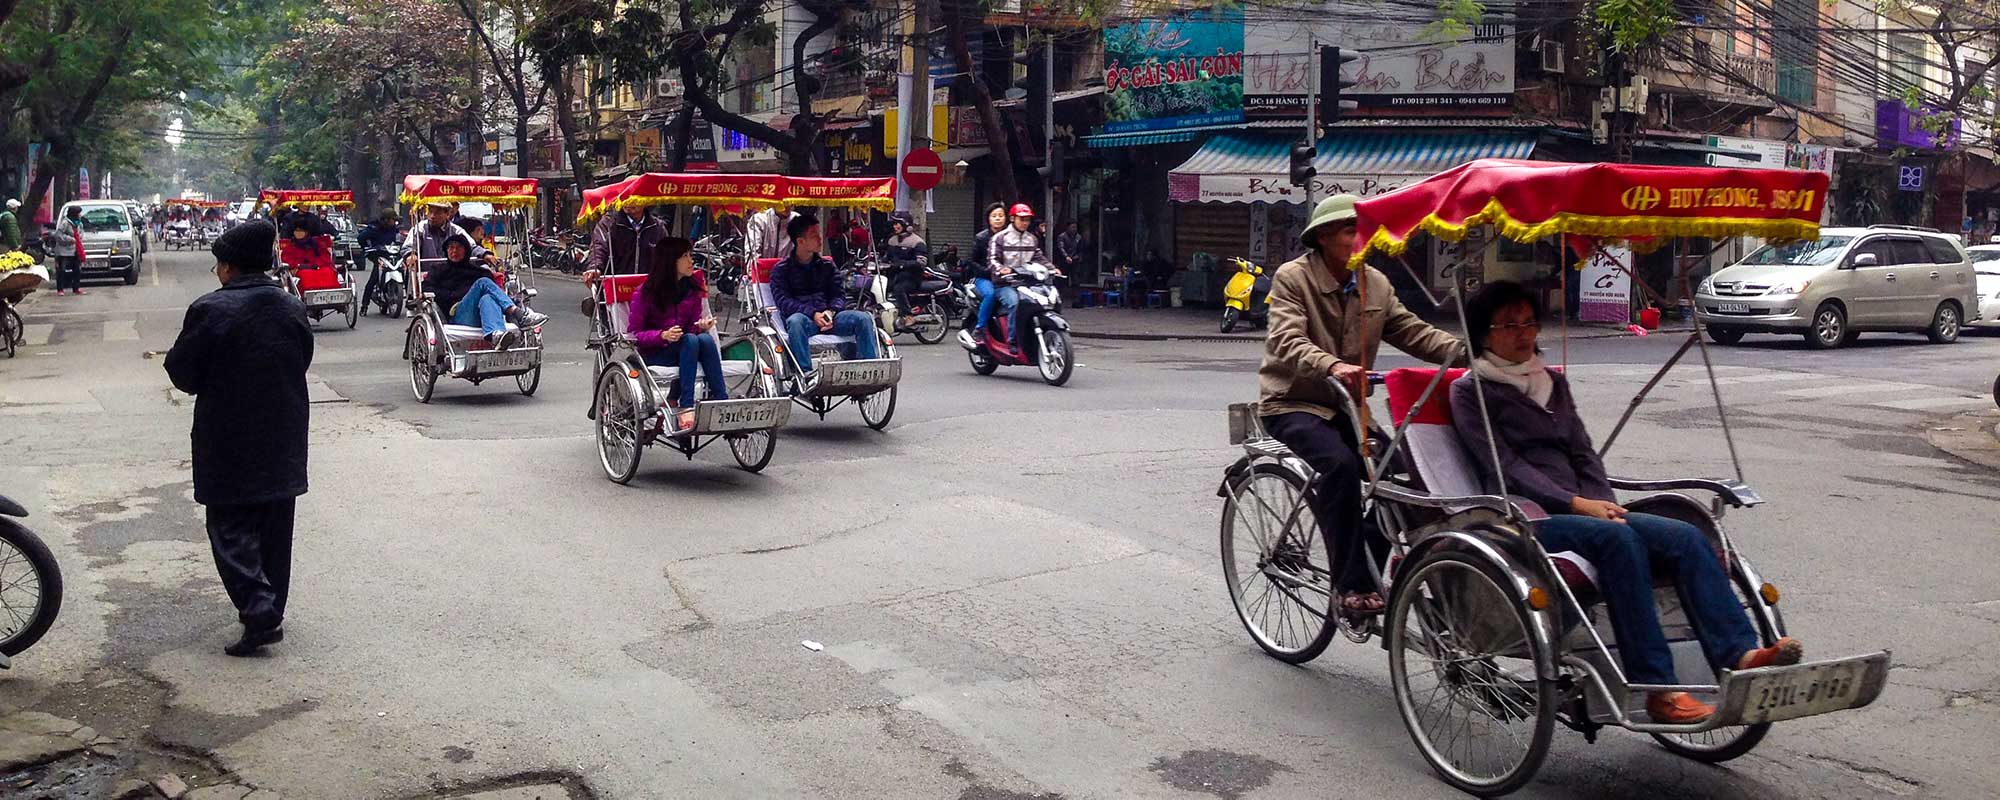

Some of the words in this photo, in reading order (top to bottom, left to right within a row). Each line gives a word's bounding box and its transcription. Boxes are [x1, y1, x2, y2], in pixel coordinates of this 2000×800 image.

[1131, 58, 1162, 89] GÁI
[1201, 47, 1243, 78] GÒN
[1275, 96, 1299, 105] HÀNG
[458, 184, 474, 194] HUY
[507, 185, 520, 194] JSC
[683, 183, 703, 193] HUY
[743, 184, 759, 193] JSC
[761, 183, 776, 195] 32
[809, 186, 827, 195] HUY
[1668, 187, 1704, 208] HUY
